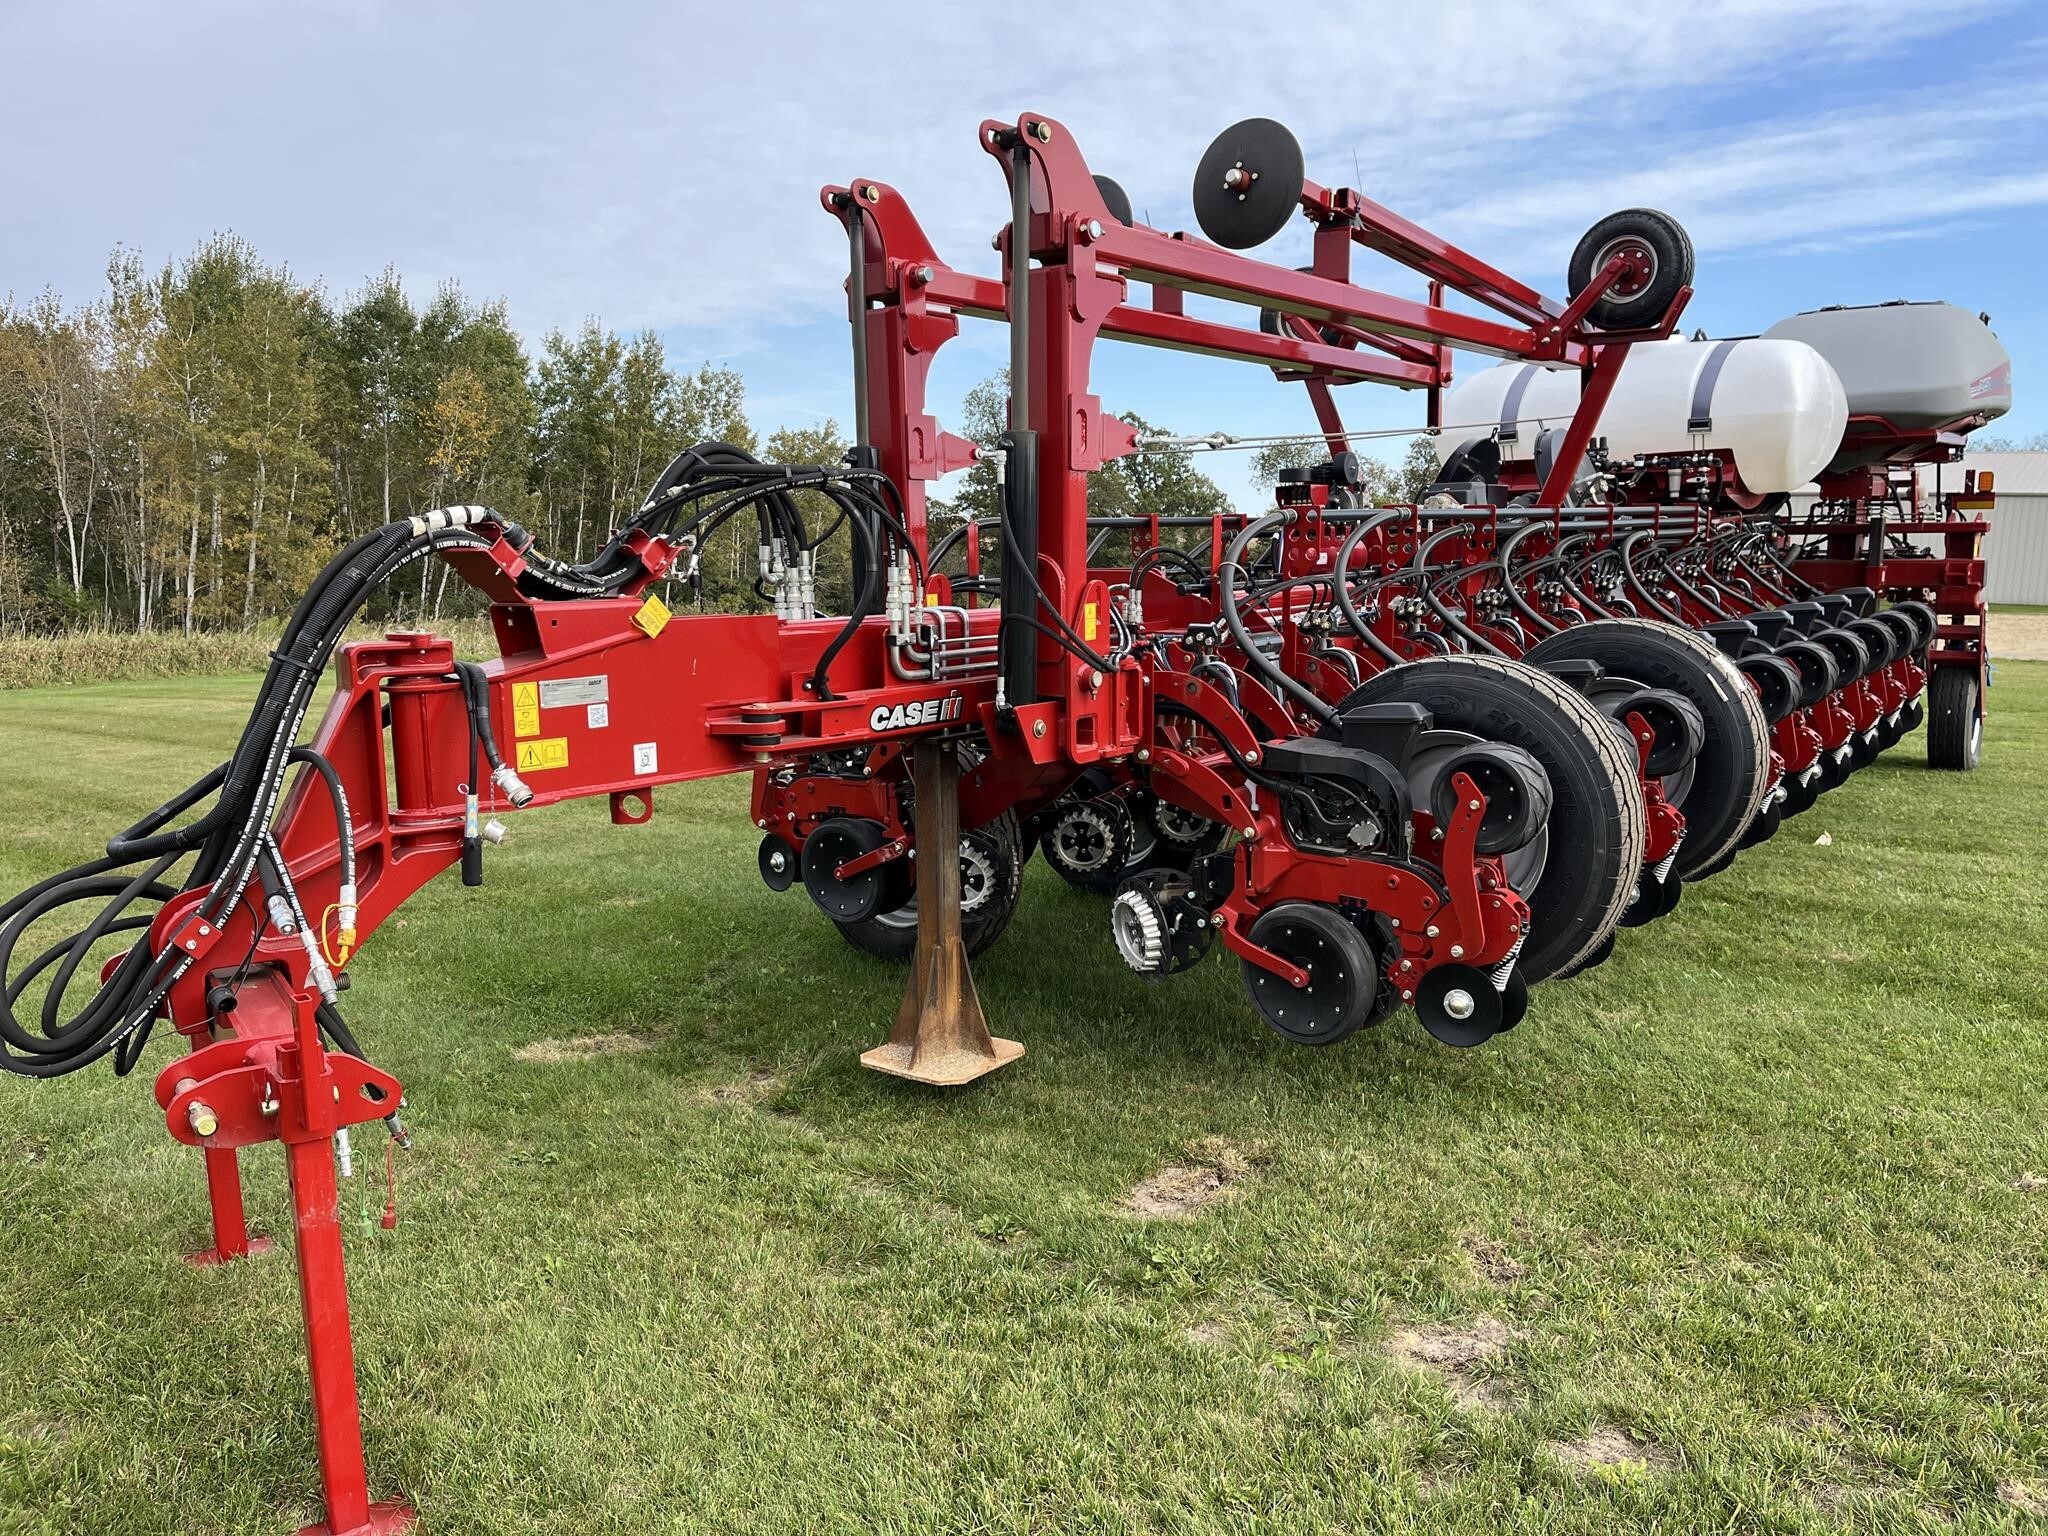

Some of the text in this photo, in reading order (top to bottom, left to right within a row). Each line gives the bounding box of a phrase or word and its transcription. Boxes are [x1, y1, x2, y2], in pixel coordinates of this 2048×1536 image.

[285, 708, 304, 747] PULSAR
[870, 700, 940, 731] CASE
[242, 856, 256, 881] EXCEEDS
[236, 880, 246, 892] SAE
[225, 892, 240, 914] 100R17
